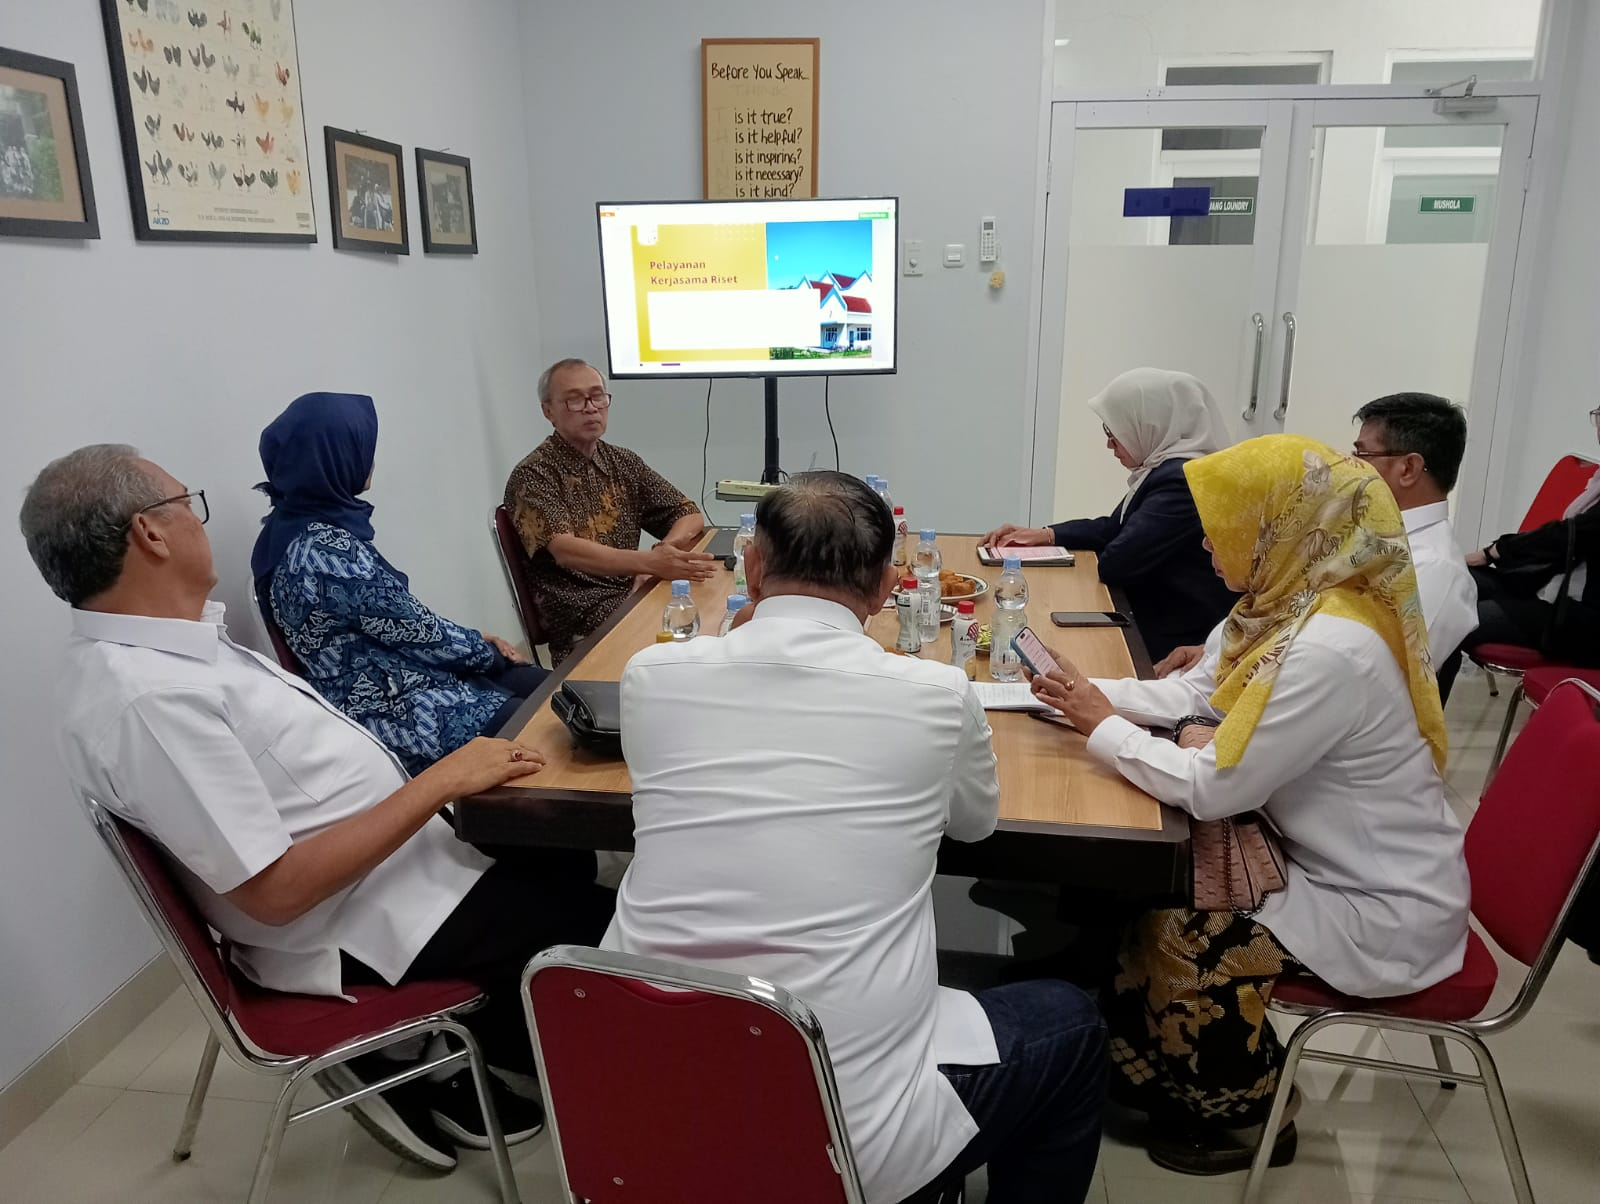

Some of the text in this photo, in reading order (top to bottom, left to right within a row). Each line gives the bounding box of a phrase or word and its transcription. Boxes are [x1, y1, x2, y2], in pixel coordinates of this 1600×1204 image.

[711, 62, 749, 80] Before
[752, 63, 773, 80] You
[734, 107, 744, 124] is
[746, 107, 757, 125] it
[760, 107, 794, 125] true?
[735, 128, 744, 145] is
[747, 127, 758, 144] it
[760, 127, 804, 147] helpful?
[735, 148, 744, 164] is
[745, 148, 755, 164] it
[756, 148, 803, 167] inspiring?
[735, 165, 743, 180] is
[745, 165, 754, 181] it
[755, 166, 804, 184] necessary?
[735, 183, 746, 198] is
[749, 183, 760, 198] it
[764, 183, 795, 199] kind?
[1223, 201, 1249, 211] LOUNDRY
[1433, 199, 1461, 209] MUSHOLA
[650, 261, 706, 271] Pelayanan
[651, 275, 738, 286] Kerjasama Riset
